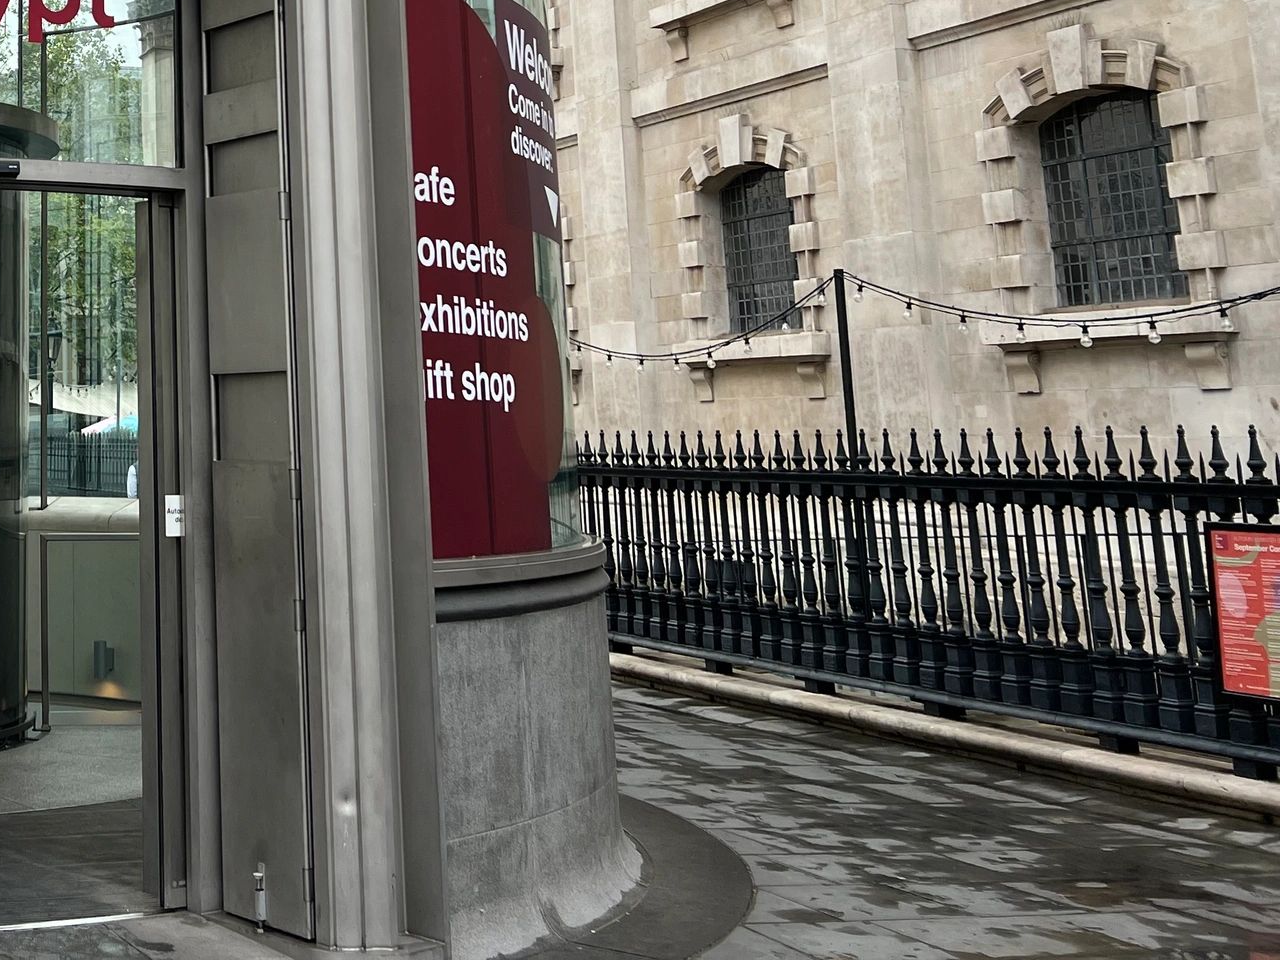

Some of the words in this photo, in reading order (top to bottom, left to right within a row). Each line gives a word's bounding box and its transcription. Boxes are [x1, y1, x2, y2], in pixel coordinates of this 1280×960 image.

[503, 19, 554, 102] Welco
[508, 82, 541, 126] Come
[541, 101, 549, 134] in
[414, 166, 456, 206] afe
[417, 236, 508, 278] oncerts
[419, 293, 529, 342] xhibitions
[423, 358, 455, 400] ift
[461, 361, 516, 412] shop
